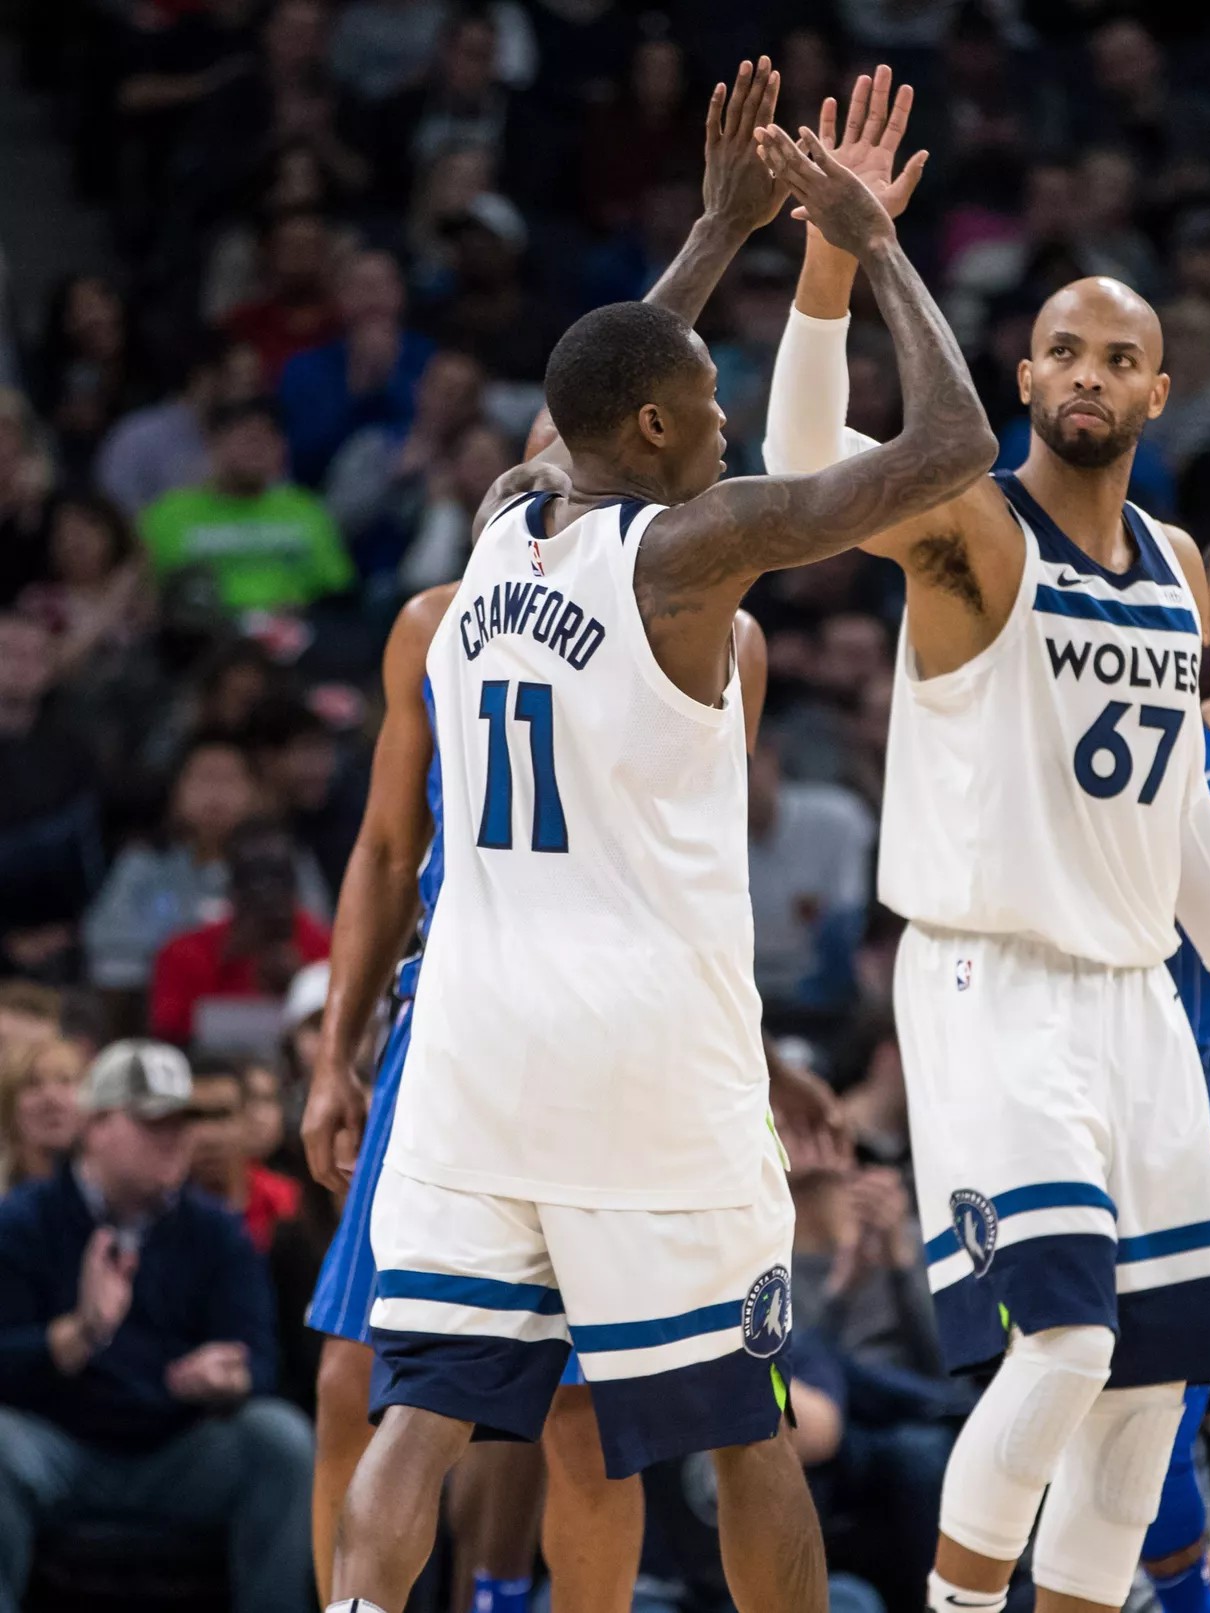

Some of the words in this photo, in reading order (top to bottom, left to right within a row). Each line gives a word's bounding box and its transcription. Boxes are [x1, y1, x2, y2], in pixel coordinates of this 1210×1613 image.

[460, 581, 605, 670] CRAWFORD
[1046, 637, 1200, 694] WOLVES
[476, 679, 569, 853] 11
[1073, 699, 1186, 806] 67
